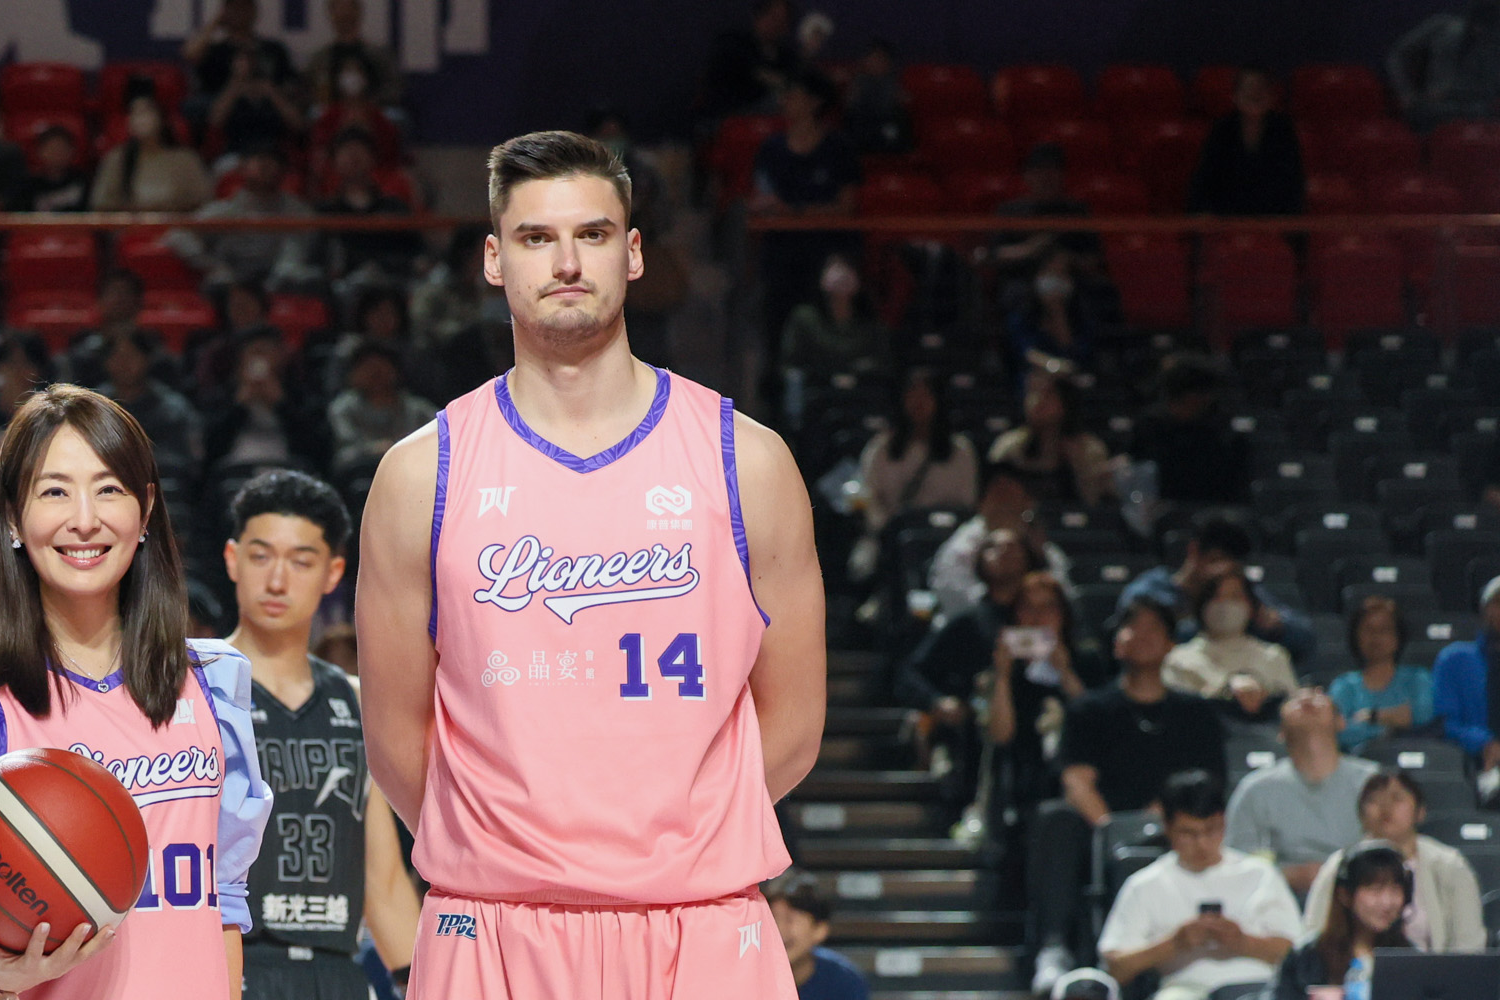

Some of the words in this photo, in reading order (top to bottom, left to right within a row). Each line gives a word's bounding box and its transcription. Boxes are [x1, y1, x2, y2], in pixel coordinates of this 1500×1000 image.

[474, 535, 699, 620] Lioneers
[619, 633, 706, 701] 14
[69, 743, 221, 790] oneers
[257, 738, 366, 821] AIPEI
[277, 813, 336, 882] 33
